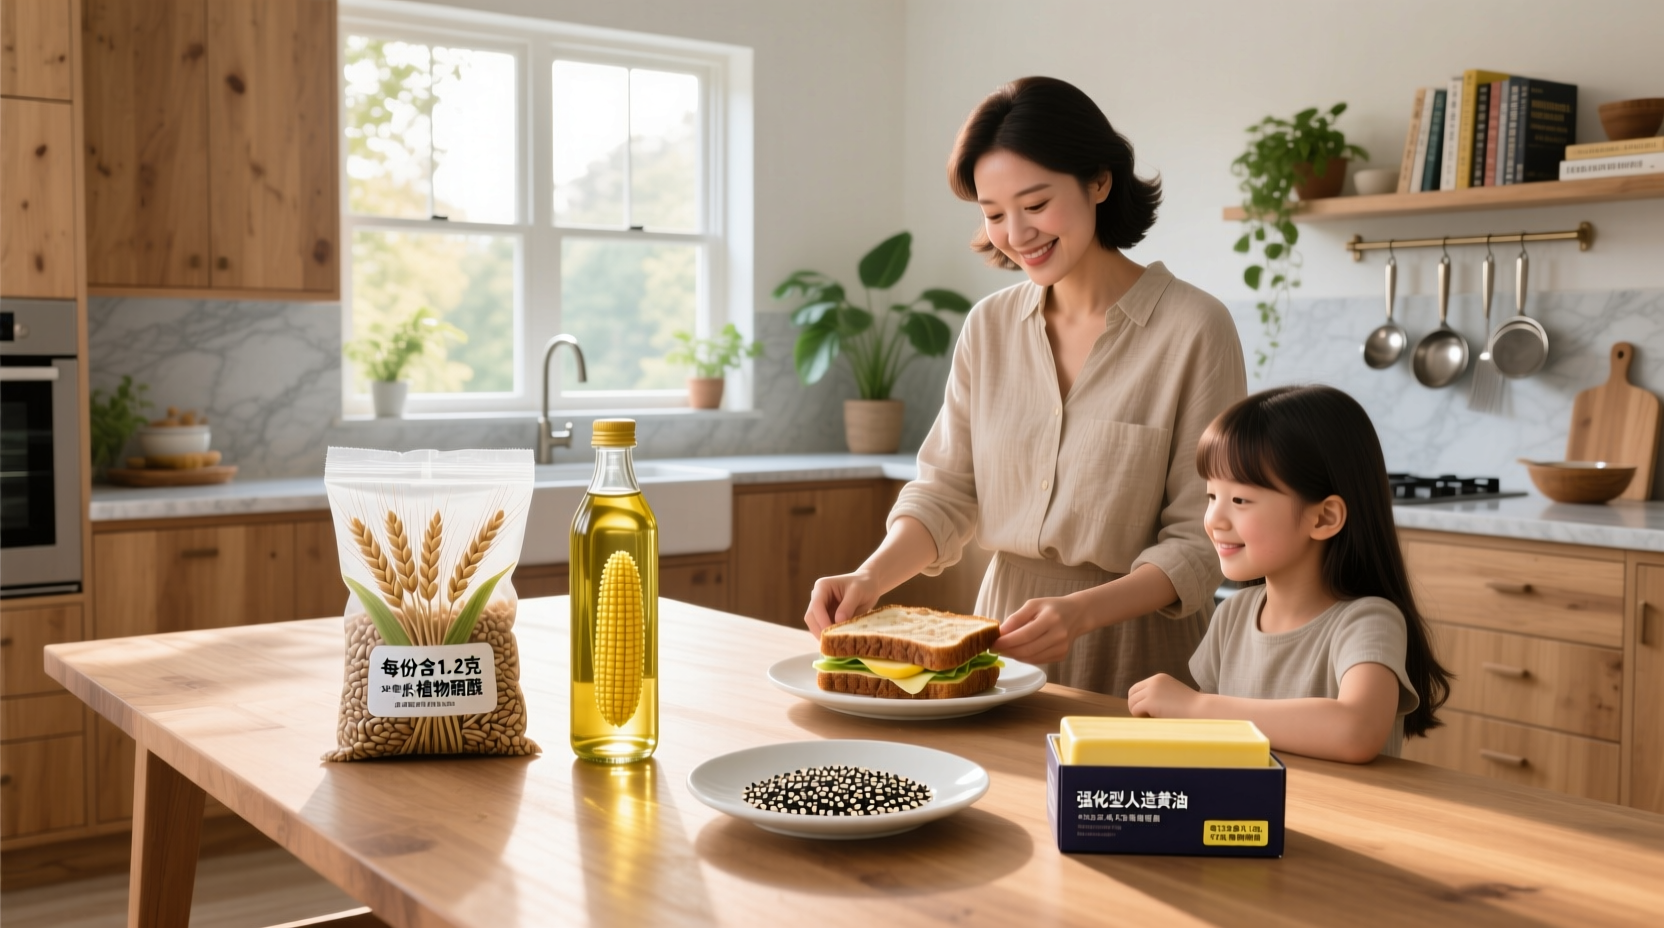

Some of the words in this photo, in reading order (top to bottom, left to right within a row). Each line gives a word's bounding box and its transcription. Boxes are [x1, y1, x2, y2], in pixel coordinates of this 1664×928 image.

[1077, 790, 1189, 810] 强化型人造黄油
